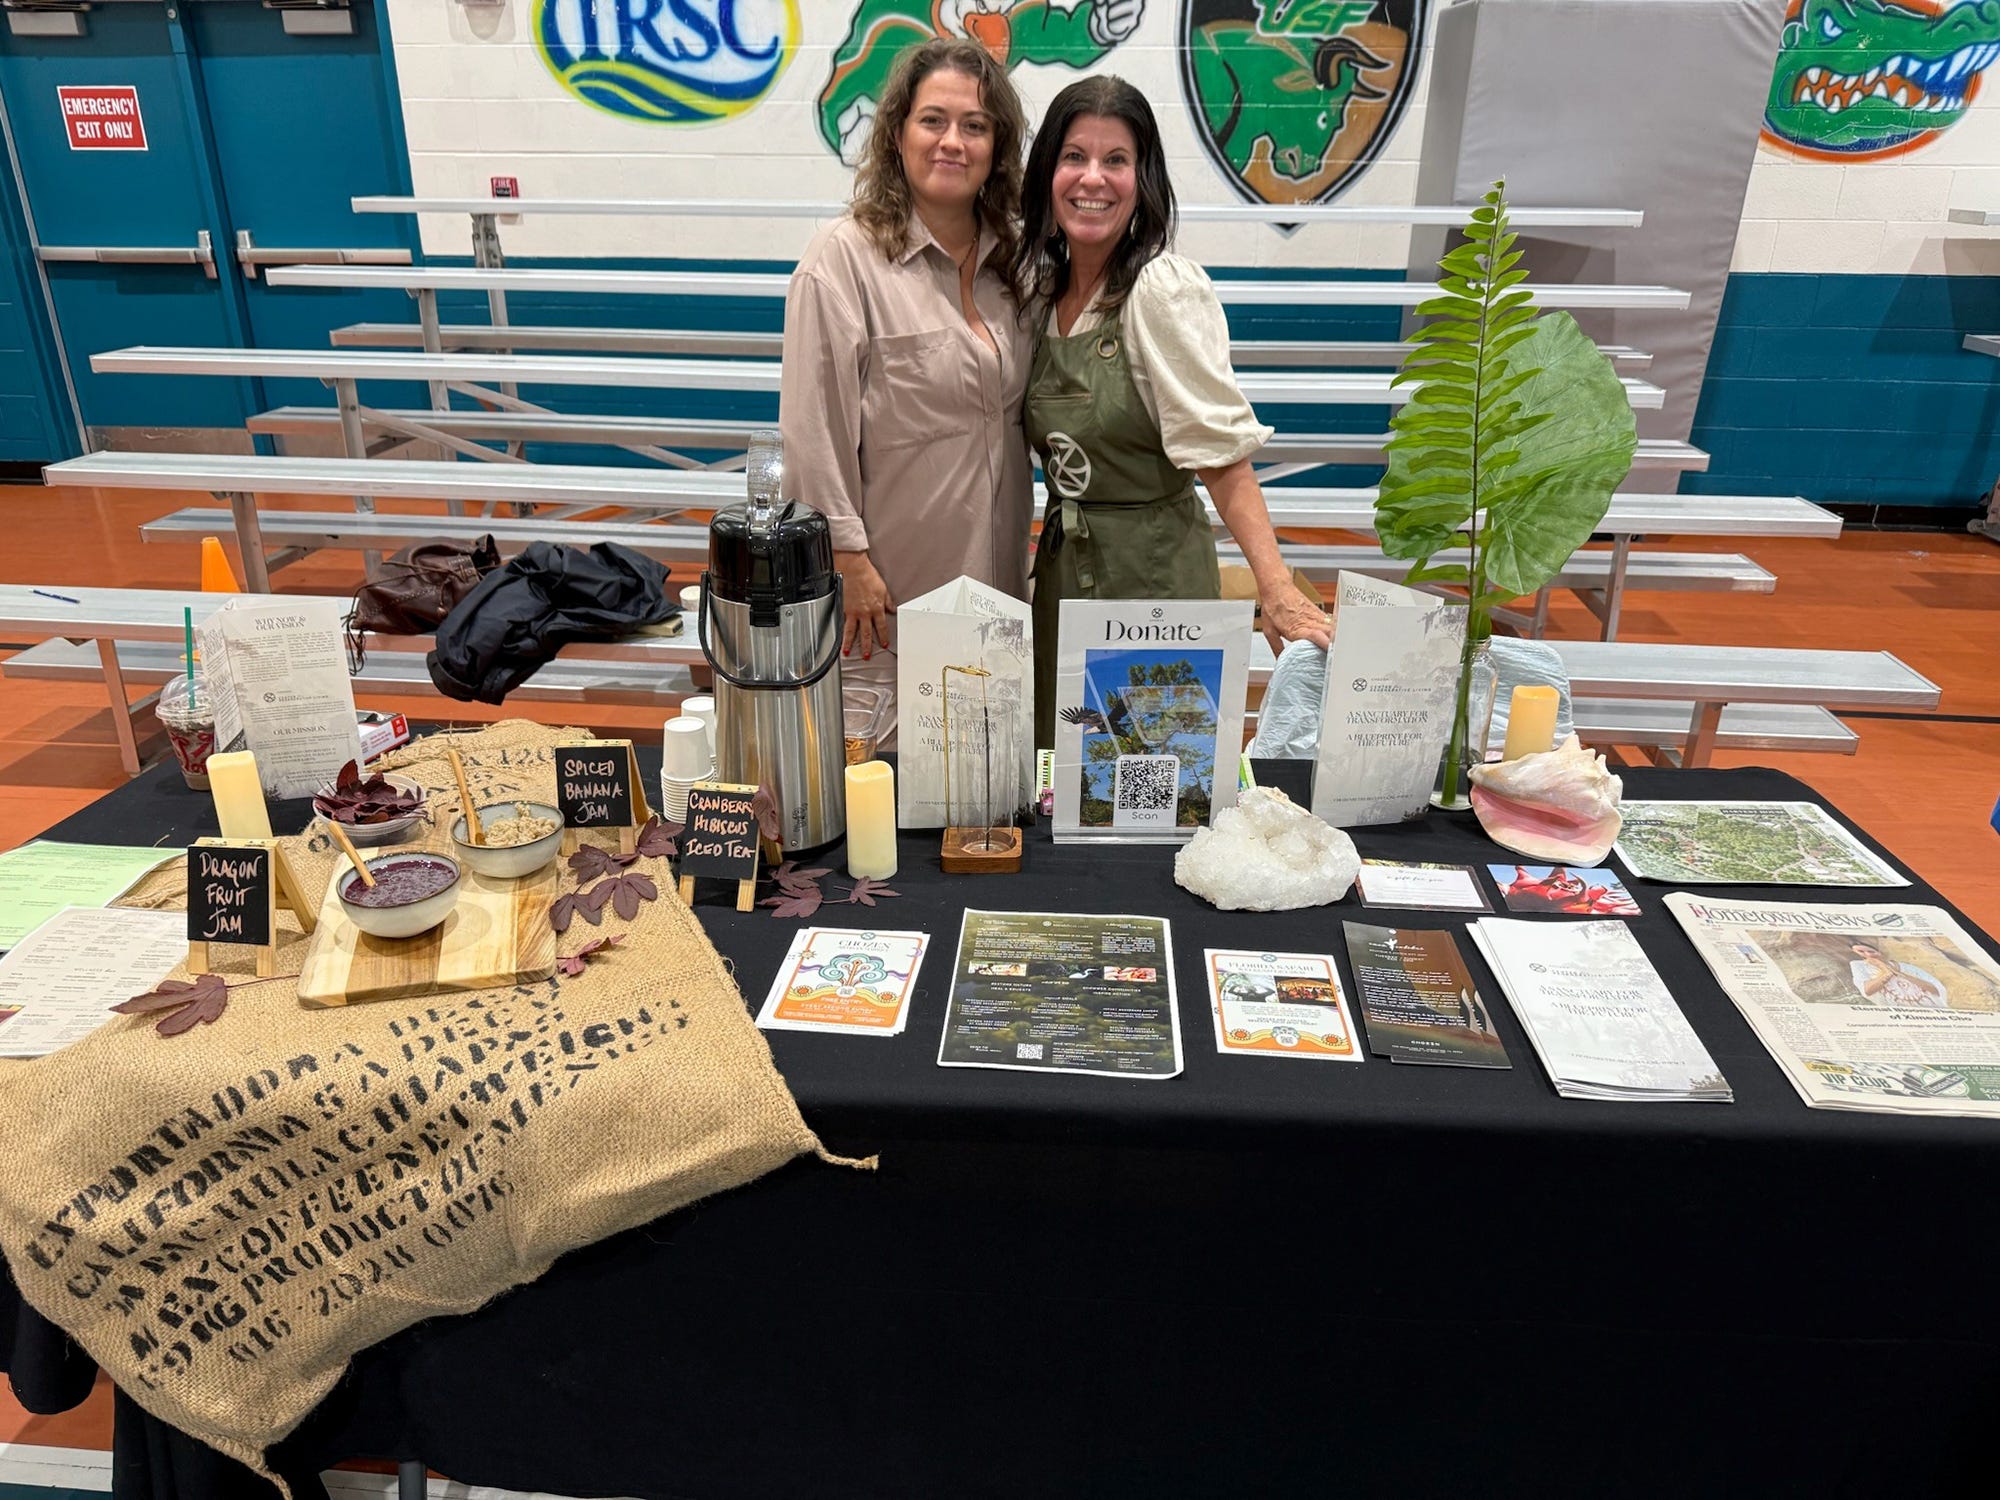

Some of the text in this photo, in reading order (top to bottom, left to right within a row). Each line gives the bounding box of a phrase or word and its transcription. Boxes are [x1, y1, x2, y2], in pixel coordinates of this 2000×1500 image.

[63, 97, 135, 116] EMERGENCY
[75, 121, 134, 139] EXIT ONLY
[1105, 620, 1202, 641] Donate
[273, 725, 327, 736] OUR MISSION
[564, 759, 615, 777] SPICED
[564, 782, 623, 800] BANANA
[574, 801, 609, 824] JAM
[689, 792, 755, 819] CRANBERRY
[1132, 811, 1158, 820] Scan
[694, 816, 748, 836] HIBISCUS
[685, 839, 756, 859] ICED TEA
[200, 852, 263, 888] DRAGON
[204, 883, 256, 907] FRUIT
[203, 908, 242, 938] JAM
[1686, 902, 1809, 925] Hometown
[1803, 911, 1872, 928] News
[1821, 1073, 1892, 1089] VIP CLUB
